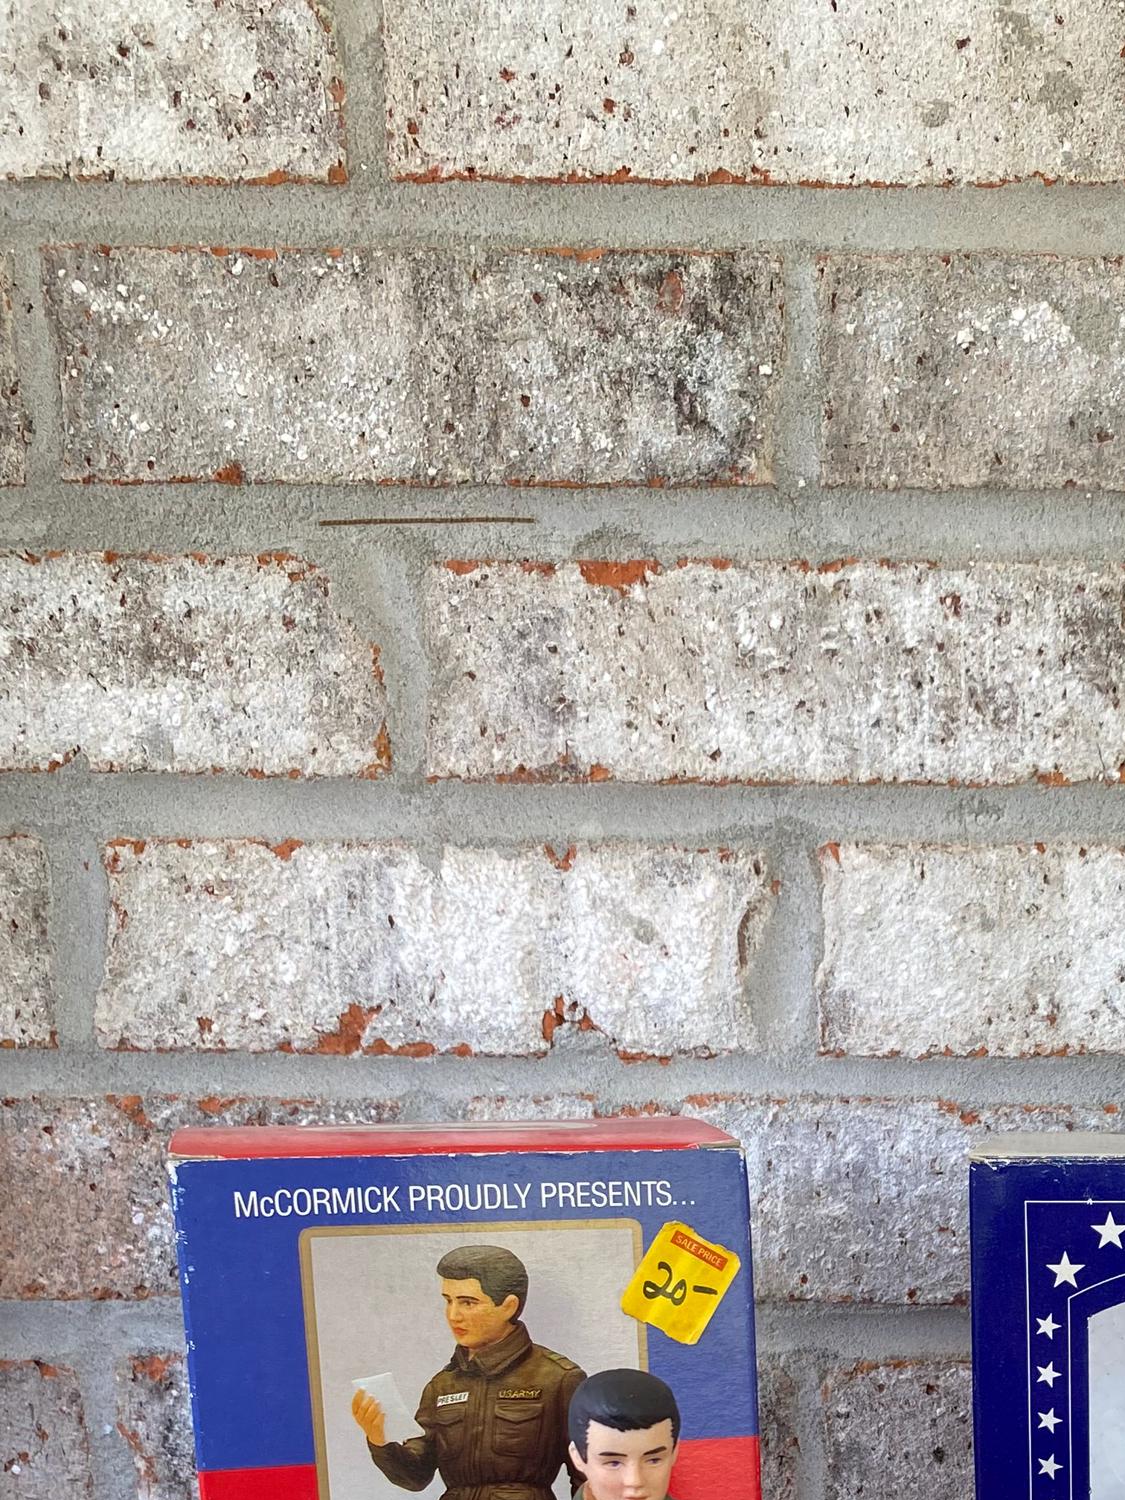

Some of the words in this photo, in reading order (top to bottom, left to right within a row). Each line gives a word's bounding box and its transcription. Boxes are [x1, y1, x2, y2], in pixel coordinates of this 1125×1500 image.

[233, 1185, 402, 1218] McCORMICK
[408, 1182, 532, 1212] PROUDLY
[540, 1180, 697, 1208] PRESENTS...
[675, 1234, 699, 1252] SALE
[698, 1246, 723, 1267] PRICE
